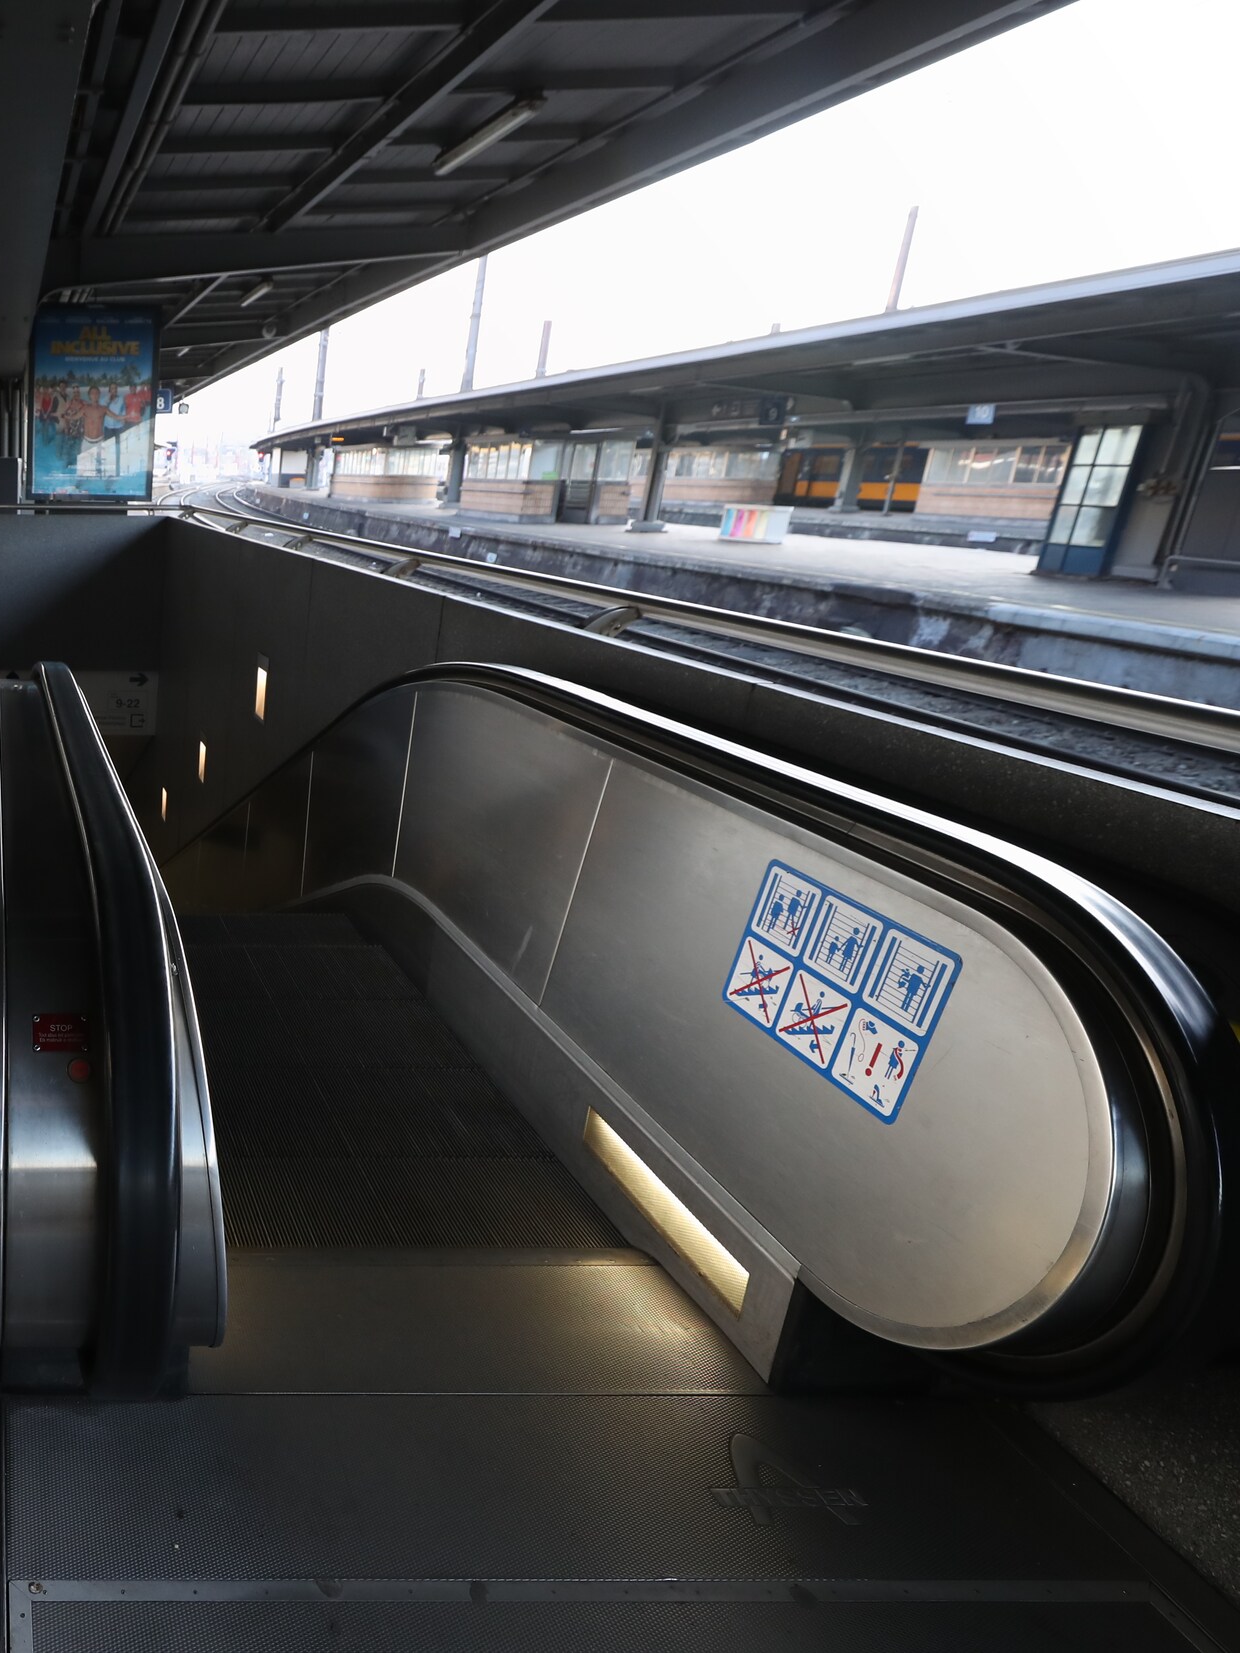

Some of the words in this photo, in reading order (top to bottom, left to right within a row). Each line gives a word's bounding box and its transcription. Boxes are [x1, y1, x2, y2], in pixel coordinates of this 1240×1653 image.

[79, 326, 112, 340] ALL
[50, 340, 140, 356] INCLUSIVE
[156, 397, 164, 410] 8
[116, 698, 140, 708] 9-22
